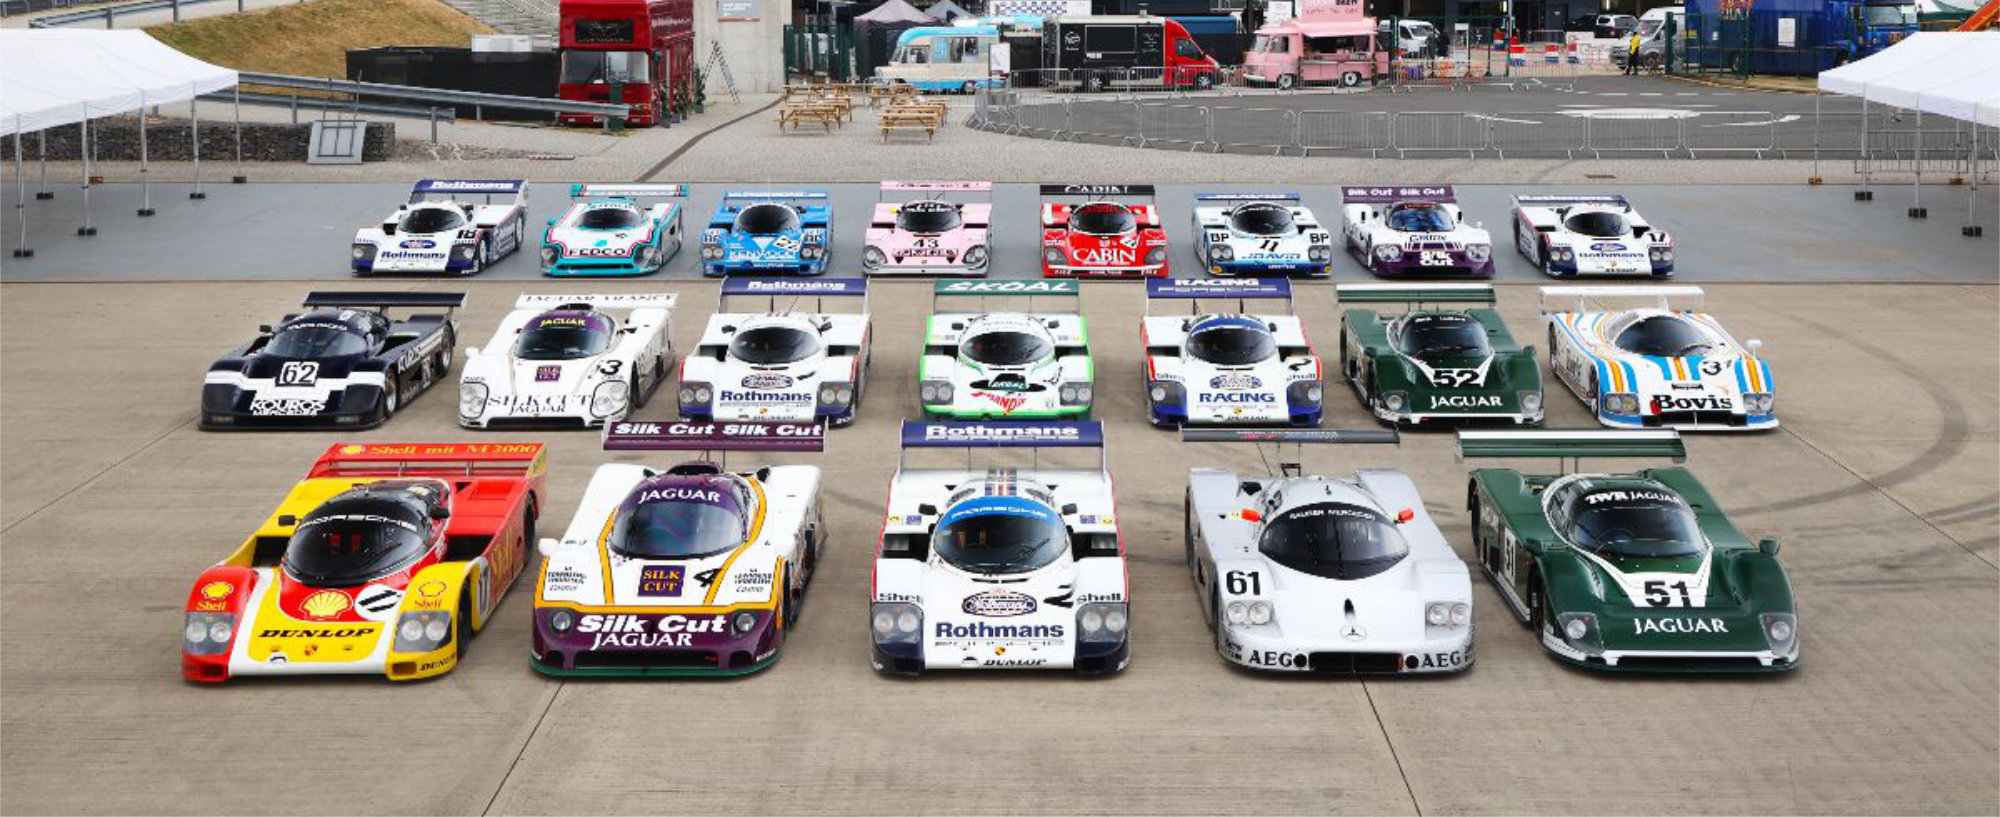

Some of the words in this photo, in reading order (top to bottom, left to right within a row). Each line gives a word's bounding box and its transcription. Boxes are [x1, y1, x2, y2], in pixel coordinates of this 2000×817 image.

[1348, 188, 1368, 196] Silk
[1371, 188, 1393, 196] Cut
[1400, 188, 1420, 196] Silk
[1423, 188, 1445, 196] Cut
[913, 239, 939, 248] 43
[1210, 233, 1229, 242] BP
[1310, 233, 1329, 243] BP
[381, 251, 446, 259] Rothmans
[729, 250, 796, 259] KENWOOD
[1073, 247, 1136, 262] CABIN
[747, 280, 846, 291] Rothmans
[943, 281, 1072, 291] SKOAL
[1174, 278, 1259, 286] RACING
[539, 318, 586, 327] JAGUAR
[282, 364, 316, 384] 62
[1432, 369, 1480, 388] 52
[720, 390, 812, 401] Rothmans
[1199, 392, 1276, 403] RACING
[1653, 393, 1733, 409] Bovis
[249, 399, 326, 412] KOUROS
[1430, 396, 1504, 409] JAGUAR
[615, 423, 662, 435] Silk
[668, 423, 716, 436] Cut
[722, 424, 769, 436] Silk
[775, 425, 824, 437] Cut
[926, 425, 1079, 441] Rothmans
[371, 446, 415, 456] Shell
[425, 446, 454, 456] mit
[638, 488, 720, 504] JAGUAR
[1585, 490, 1628, 504] TWR
[642, 569, 681, 580] SILK
[642, 581, 678, 592] CUT
[1226, 570, 1261, 595] 61
[1644, 580, 1694, 607] 51
[196, 600, 228, 612] Shell
[414, 599, 444, 610] Shell
[577, 614, 648, 633] Silk
[652, 614, 727, 633] Cut
[1634, 618, 1730, 635] JAGUAR
[258, 629, 376, 639] DUNLOP
[935, 622, 1064, 639] Rothmans
[589, 632, 693, 652] JAGUAR
[1249, 651, 1293, 669] AEG
[1421, 649, 1463, 669] AEG
